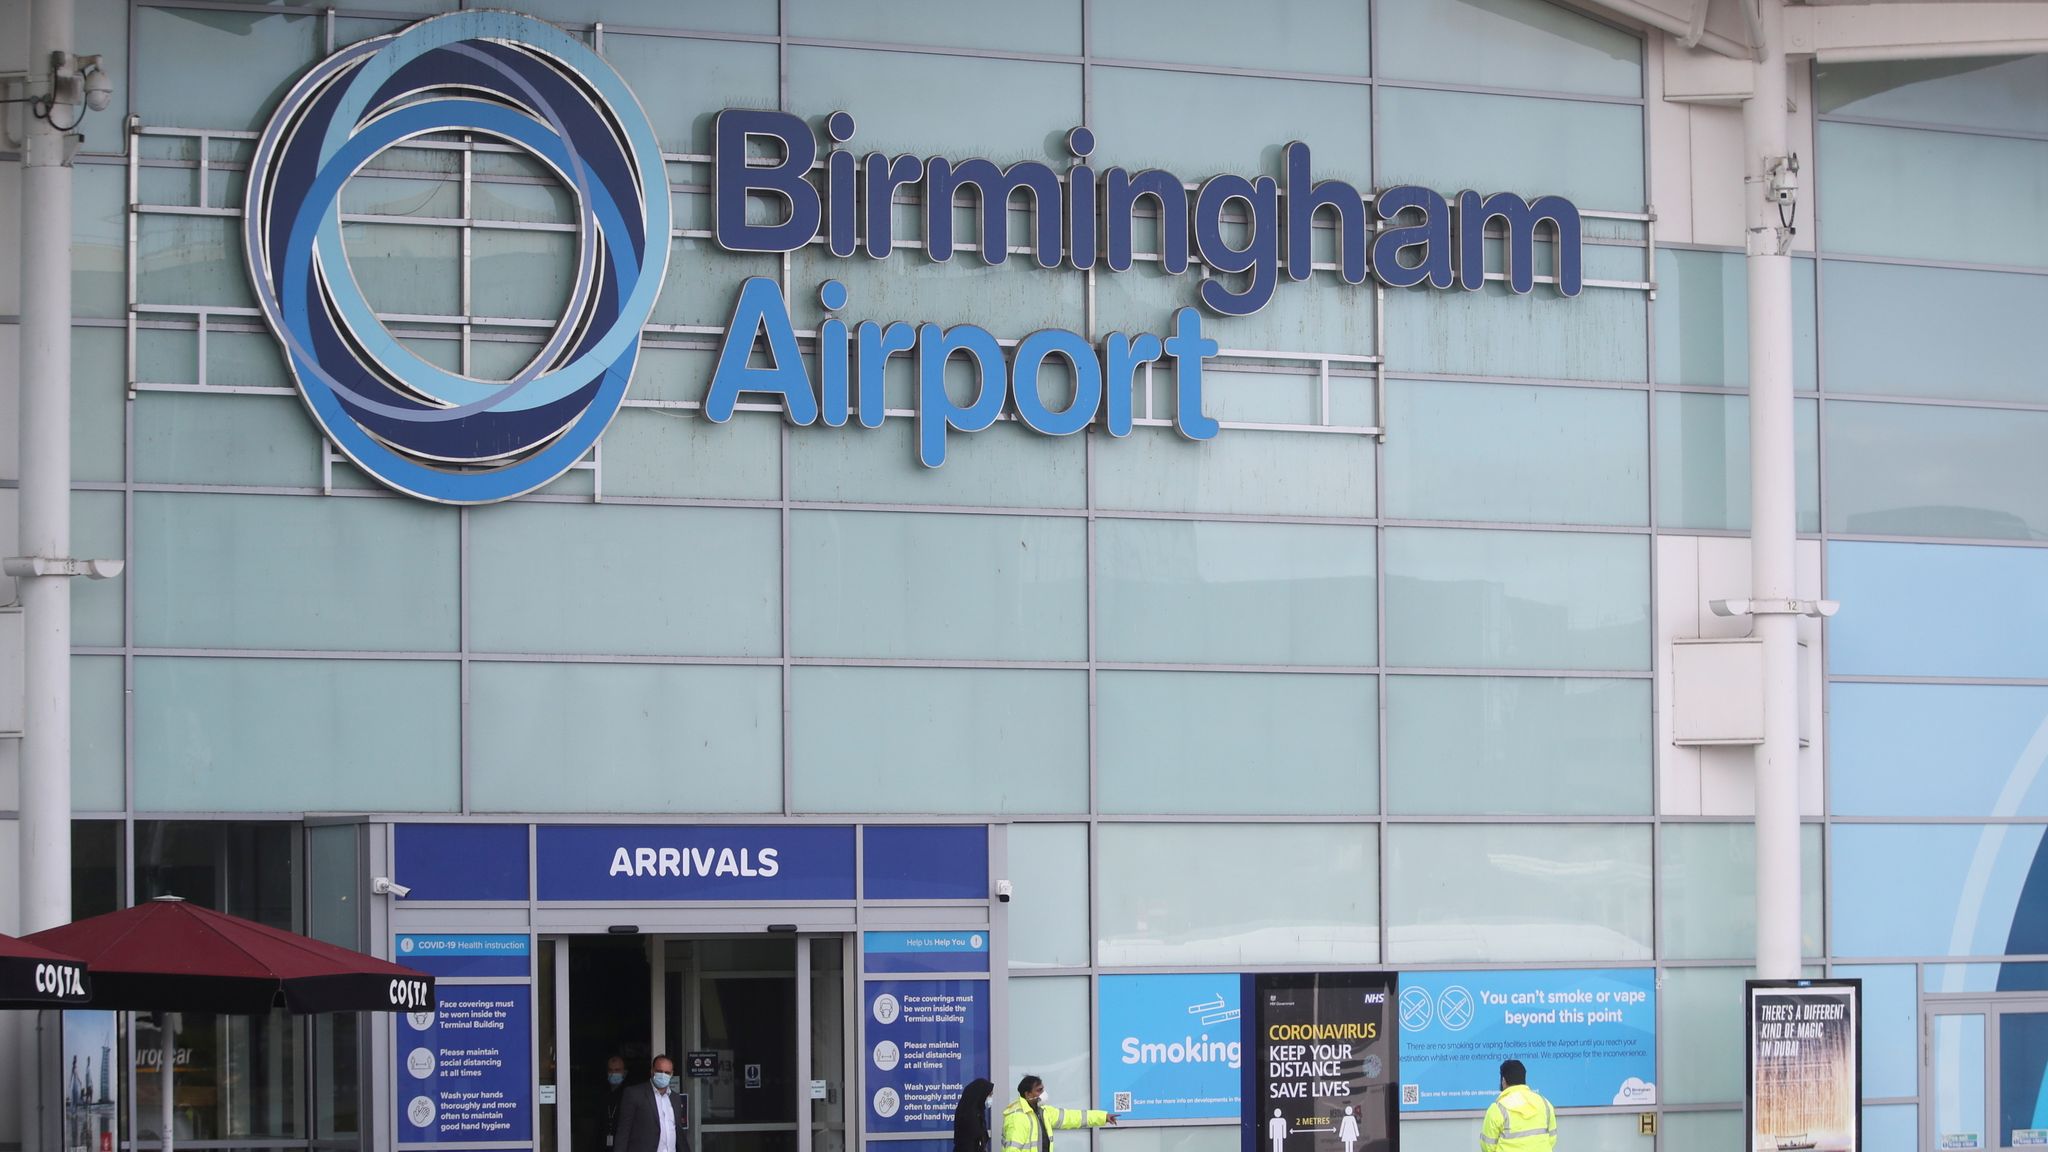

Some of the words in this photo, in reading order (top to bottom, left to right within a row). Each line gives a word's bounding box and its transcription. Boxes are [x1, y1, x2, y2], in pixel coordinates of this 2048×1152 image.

[712, 107, 1583, 317] Birmingham
[704, 275, 1219, 469] Airport
[1788, 600, 1797, 610] 12
[610, 847, 779, 877] ARRIVALS
[935, 939, 951, 947] Help
[36, 963, 86, 998] COSTA
[389, 979, 428, 1009] COSTA
[1365, 994, 1385, 1003] NHS
[1480, 990, 1507, 1004] You
[1511, 990, 1544, 1004] can't
[1548, 989, 1592, 1003] smoke
[1596, 992, 1610, 1003] or
[1614, 991, 1646, 1006] vape
[922, 995, 954, 1004] coverings
[459, 1000, 493, 1010] coverings
[1762, 1004, 1794, 1020] THERE'S
[1796, 1004, 1801, 1020] A
[1804, 1004, 1845, 1020] DIFFERENT
[936, 1015, 964, 1023] Building
[1505, 1010, 1555, 1027] beyond
[1559, 1009, 1584, 1023] this
[1588, 1008, 1623, 1026] point
[474, 1021, 504, 1030] Building
[1762, 1023, 1782, 1038] KIND
[1785, 1023, 1795, 1038] OF
[1798, 1022, 1824, 1038] MAGIC
[1270, 1023, 1376, 1041] CORONAVIRUS
[1448, 1042, 1473, 1050] smoking
[1483, 1042, 1503, 1050] vaping
[1504, 1040, 1527, 1048] facilities
[1528, 1040, 1546, 1048] inside
[1559, 1040, 1580, 1048] Airport
[1593, 1040, 1605, 1048] you
[1762, 1041, 1771, 1057] IN
[1774, 1041, 1799, 1057] DUBAI
[466, 1048, 499, 1056] maintain
[926, 1052, 962, 1060] distancing
[1122, 1034, 1241, 1069] Smoking
[1270, 1045, 1306, 1061] KEEP
[1310, 1044, 1352, 1060] YOUR
[1471, 1053, 1501, 1061] extending
[1552, 1051, 1581, 1060] apologise
[463, 1059, 502, 1068] distancing
[1270, 1062, 1341, 1078] DISTANCE
[925, 1085, 940, 1093] your
[1270, 1082, 1307, 1098] SAVE
[1312, 1081, 1350, 1097] LIVES
[463, 1094, 479, 1103] your
[904, 1094, 942, 1102] thoroughly
[441, 1102, 480, 1111] thoroughly
[904, 1114, 922, 1122] good
[1296, 1118, 1300, 1126] 2
[1302, 1117, 1330, 1125] METRES
[441, 1123, 460, 1132] good
[461, 1122, 480, 1130] hand
[482, 1122, 510, 1131] hygiene
[1642, 1115, 1654, 1133] H
